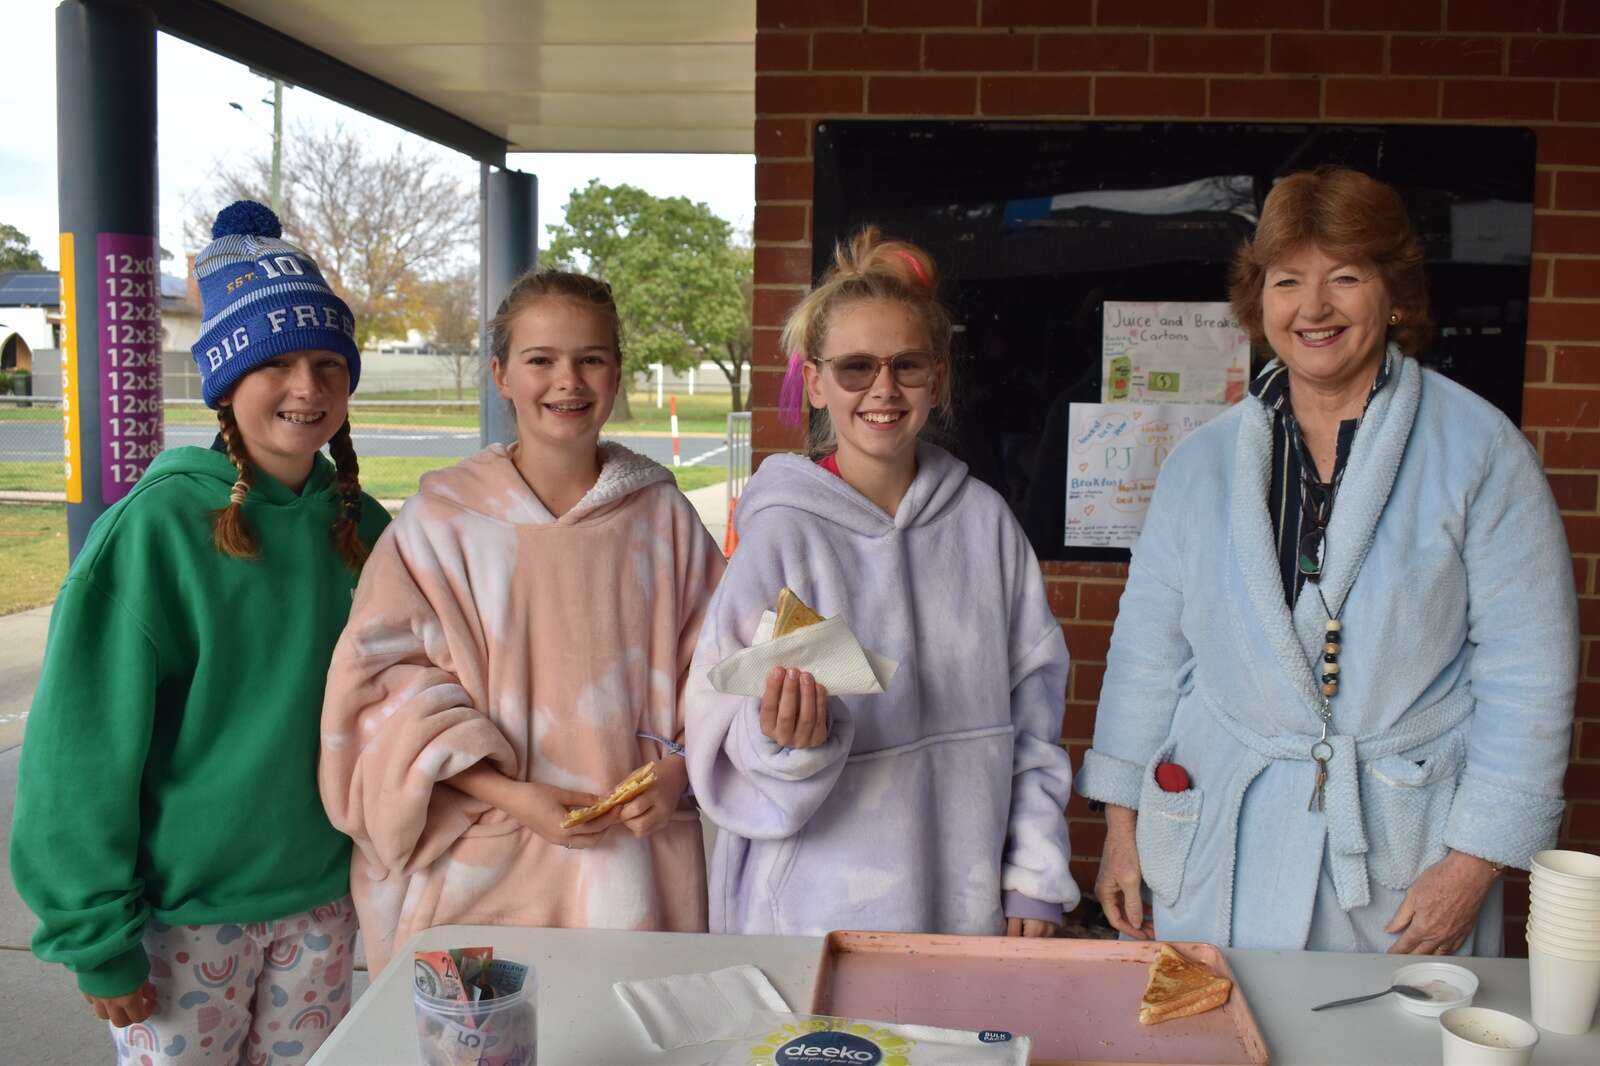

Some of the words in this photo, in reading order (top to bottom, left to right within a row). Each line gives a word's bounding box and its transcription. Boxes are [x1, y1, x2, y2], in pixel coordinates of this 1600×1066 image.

[259, 256, 304, 279] 10
[1113, 309, 1151, 328] Juice
[1160, 316, 1183, 327] and
[1140, 330, 1189, 341] Cartons
[206, 327, 250, 372] BIG
[1104, 446, 1134, 470] PJ
[458, 1031, 480, 1048] 5
[784, 1043, 873, 1061] deeko
